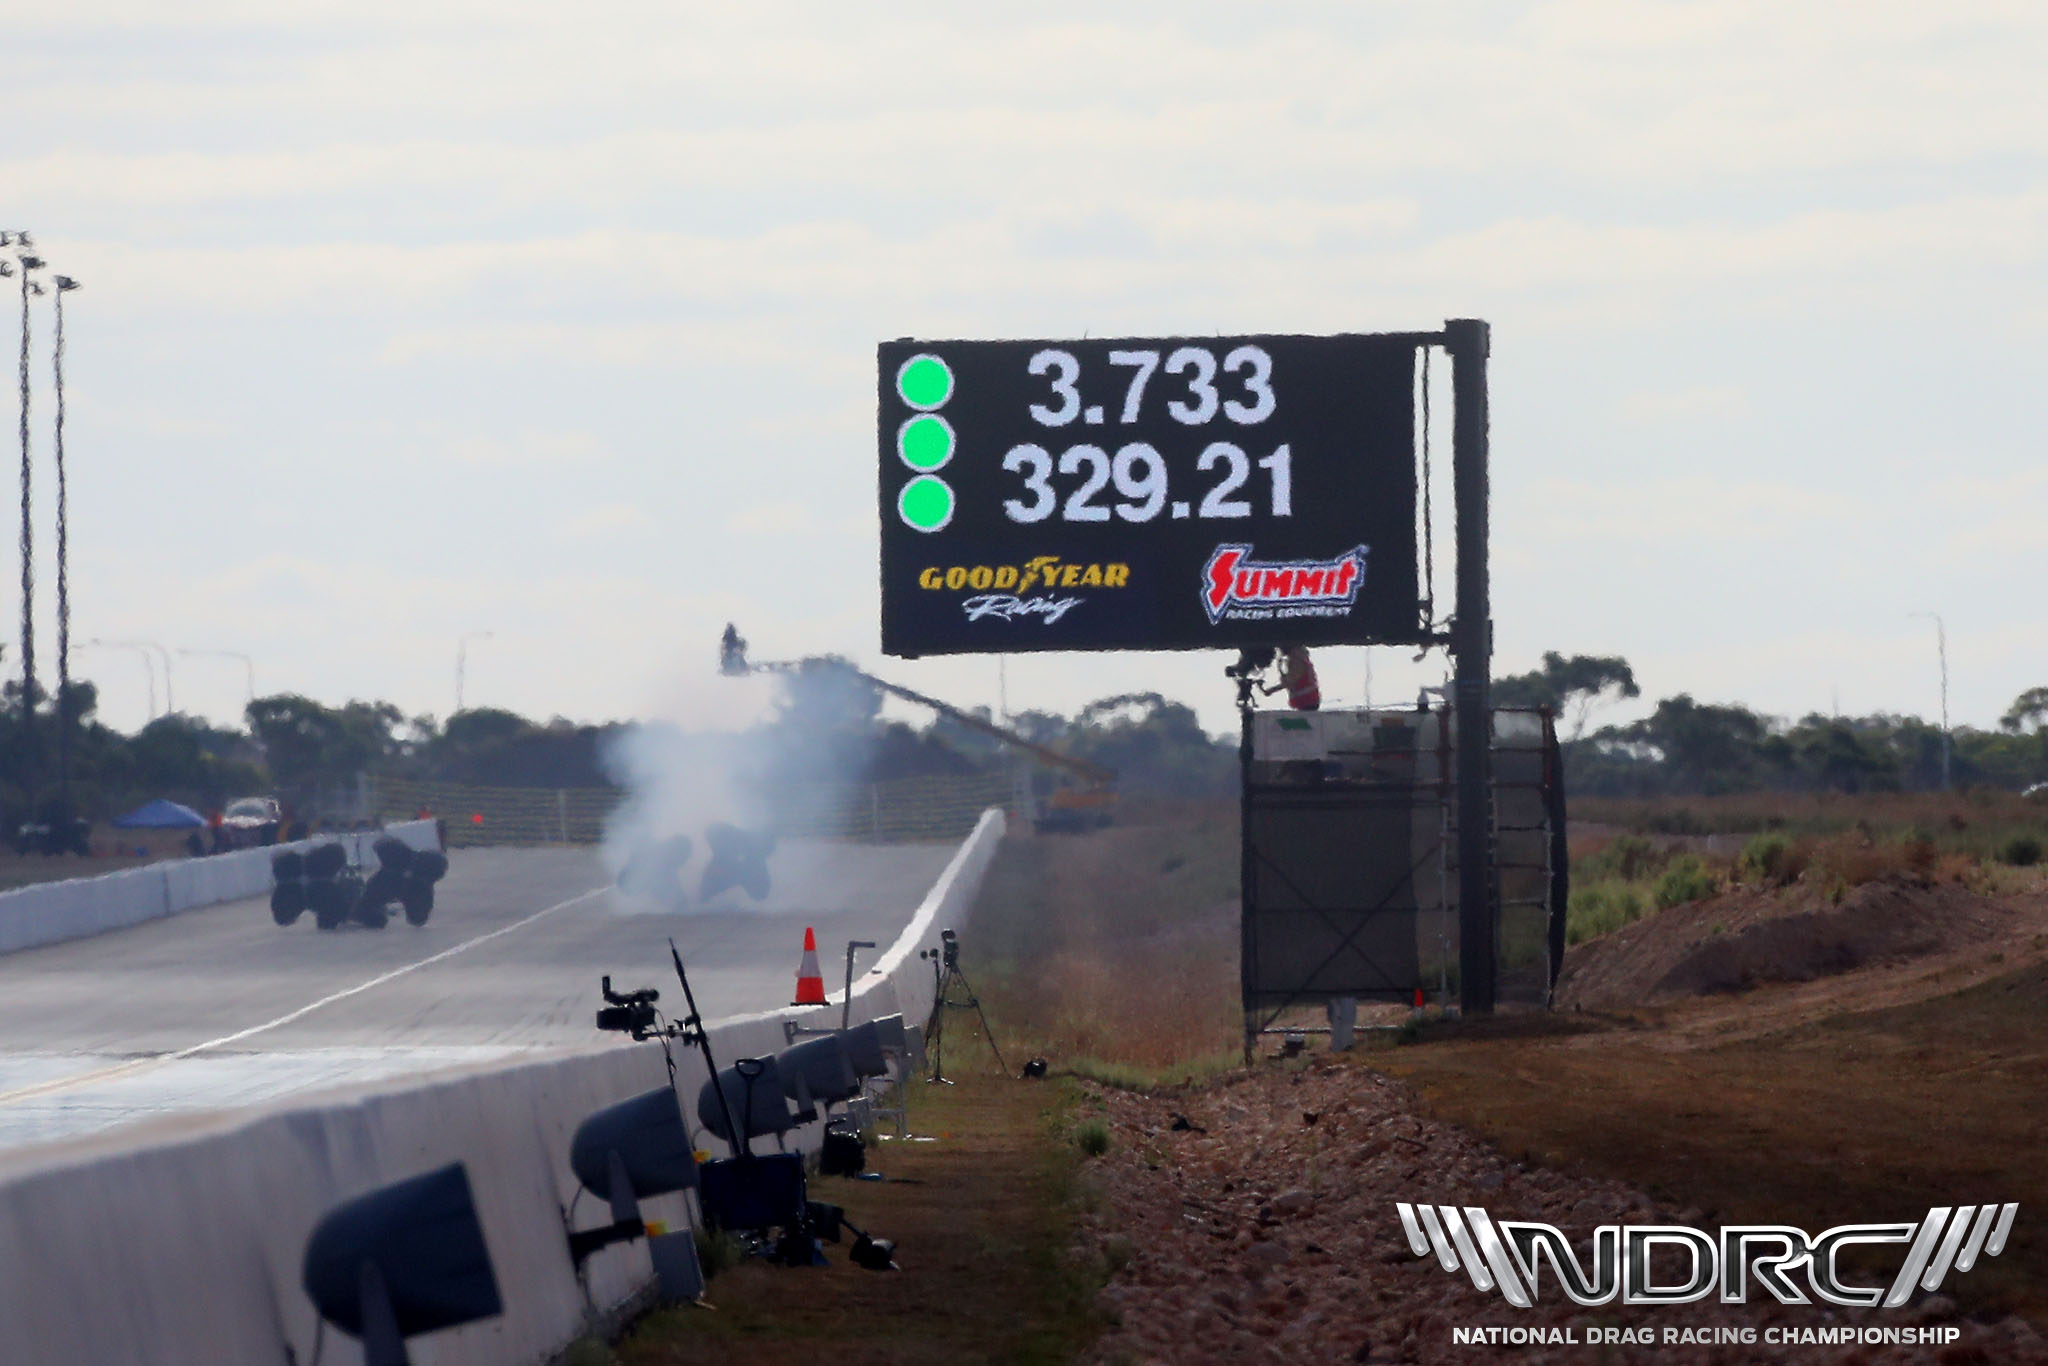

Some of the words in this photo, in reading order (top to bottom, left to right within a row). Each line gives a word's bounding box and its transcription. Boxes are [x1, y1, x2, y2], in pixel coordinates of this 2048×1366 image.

[1028, 344, 1277, 428] 3.733
[1002, 441, 1292, 524] 329.21
[918, 560, 1131, 591] GOODYEAR
[1208, 551, 1356, 608] SUMMIT
